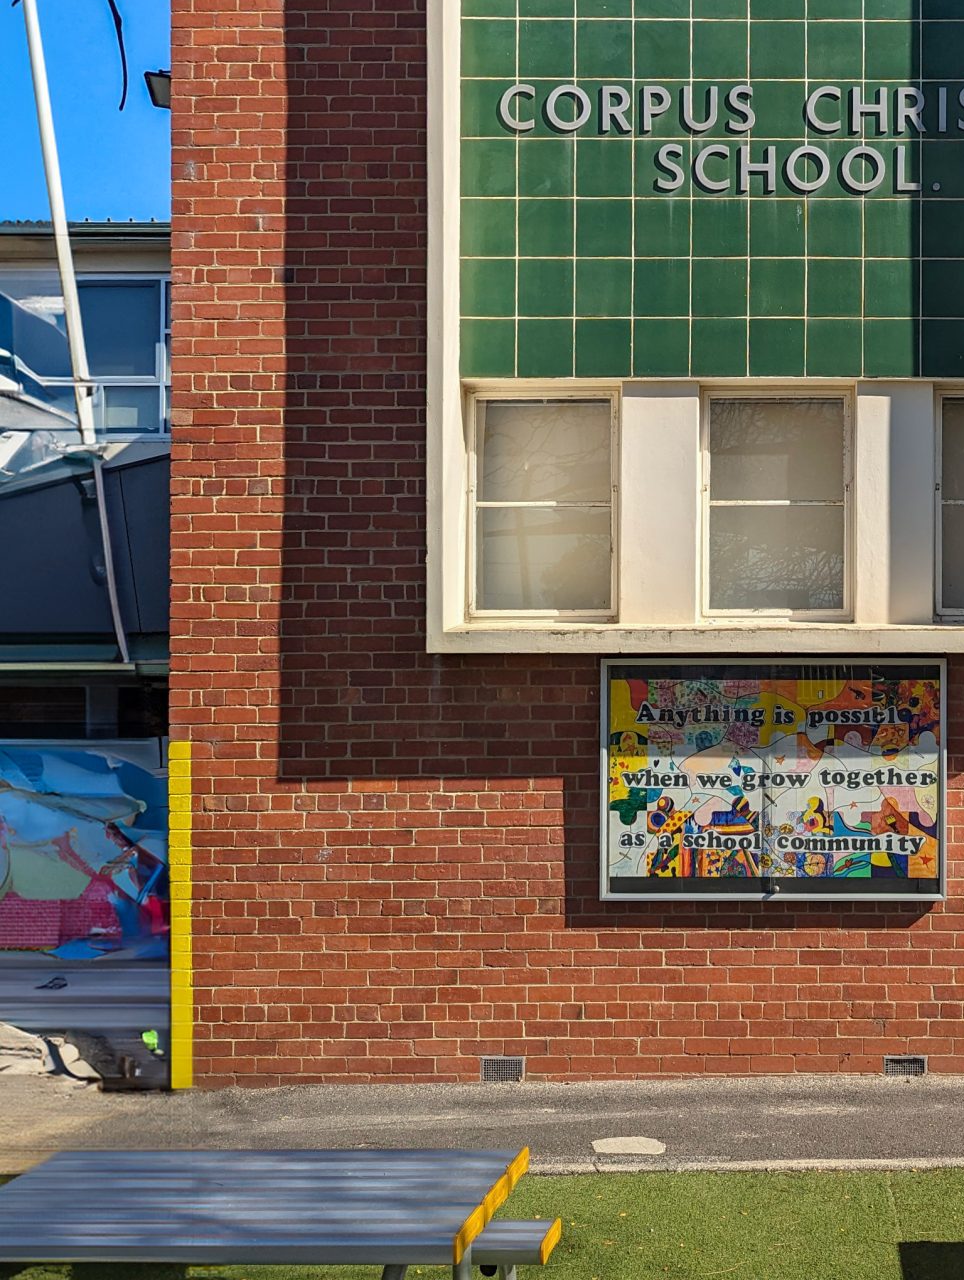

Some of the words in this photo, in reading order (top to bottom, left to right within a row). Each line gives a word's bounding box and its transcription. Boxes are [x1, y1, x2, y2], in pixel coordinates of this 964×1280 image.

[500, 84, 755, 133] CORPUS
[636, 703, 765, 727] Anything
[774, 705, 795, 725] is
[808, 707, 911, 728] possibl
[621, 770, 689, 787] when
[696, 773, 732, 787] we
[742, 772, 810, 791] grow
[820, 768, 937, 789] together
[620, 832, 646, 847] as
[658, 833, 673, 848] a
[683, 831, 761, 850] school
[776, 834, 925, 854] community
